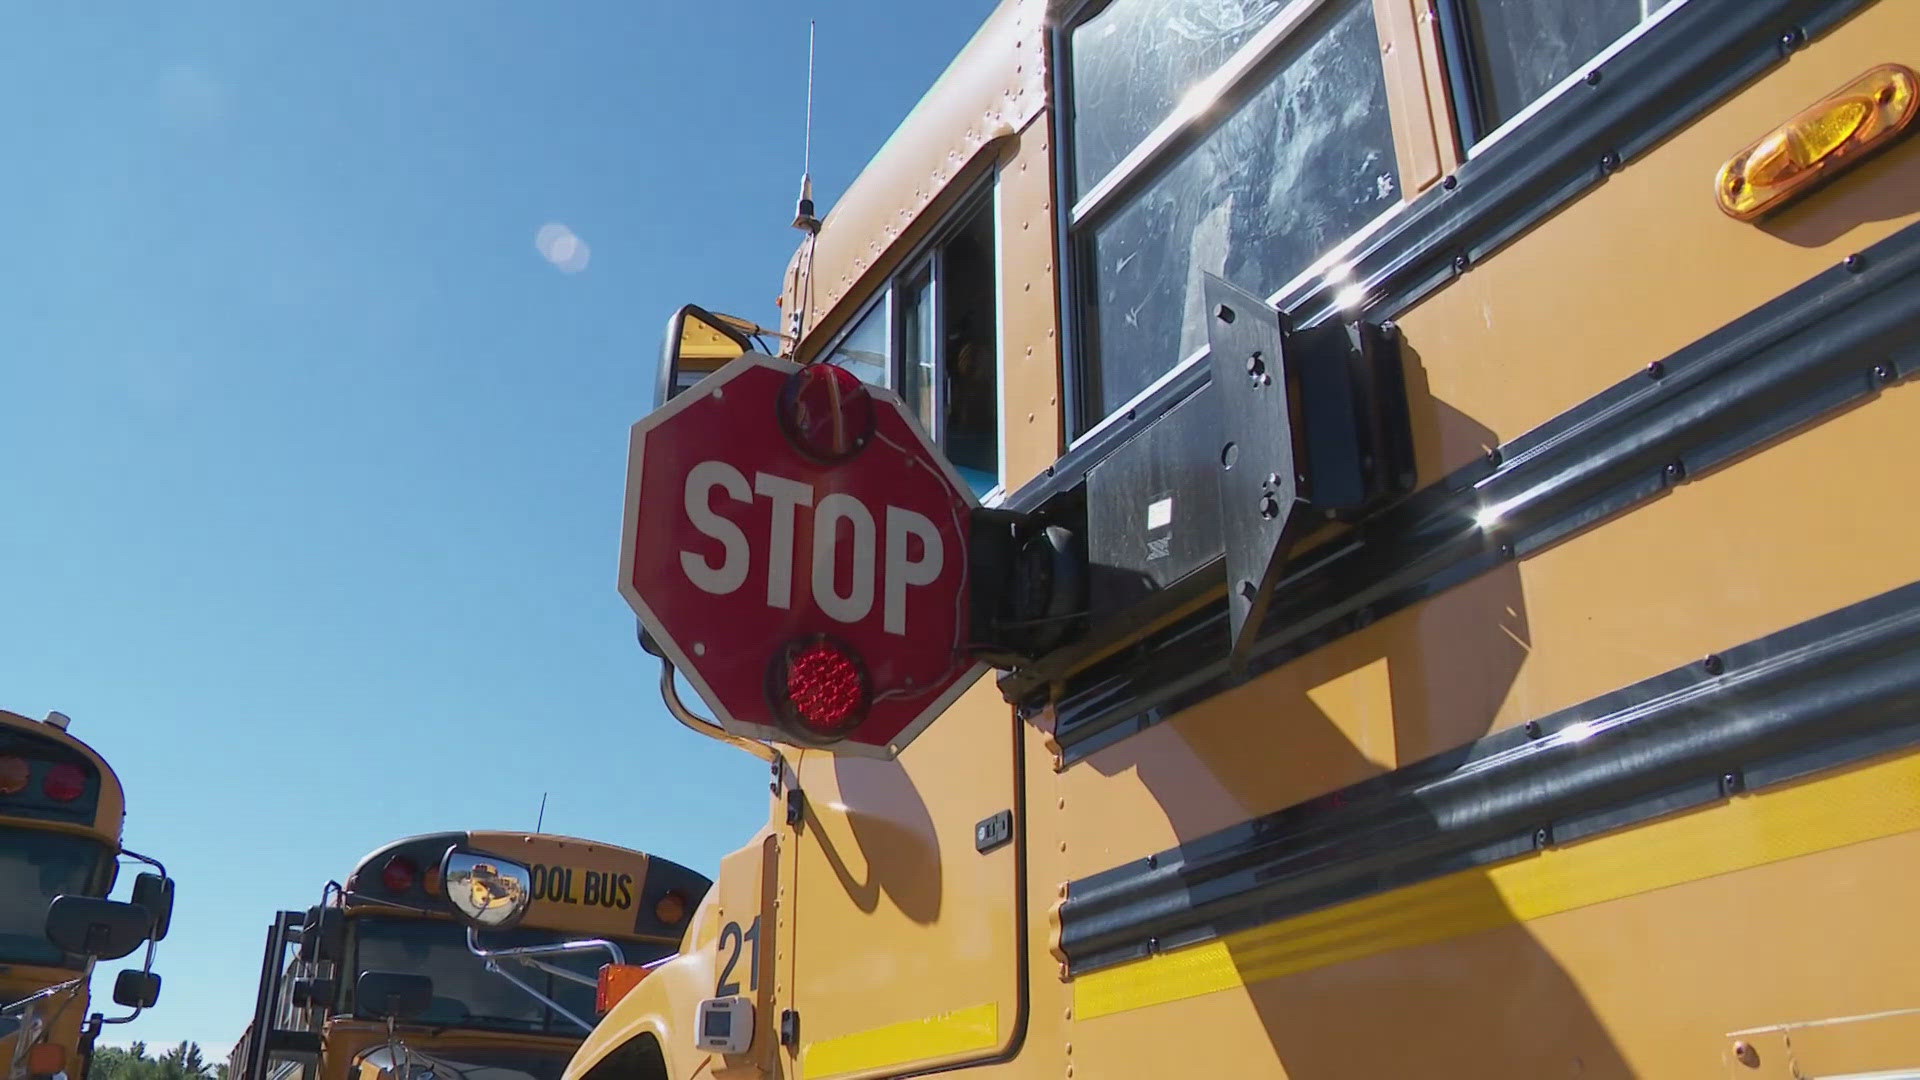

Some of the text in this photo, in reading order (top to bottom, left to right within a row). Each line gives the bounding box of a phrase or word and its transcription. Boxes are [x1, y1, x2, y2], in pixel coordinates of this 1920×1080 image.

[680, 461, 944, 636] STOP
[532, 863, 632, 910] OOL BUS
[715, 915, 760, 998] 21
